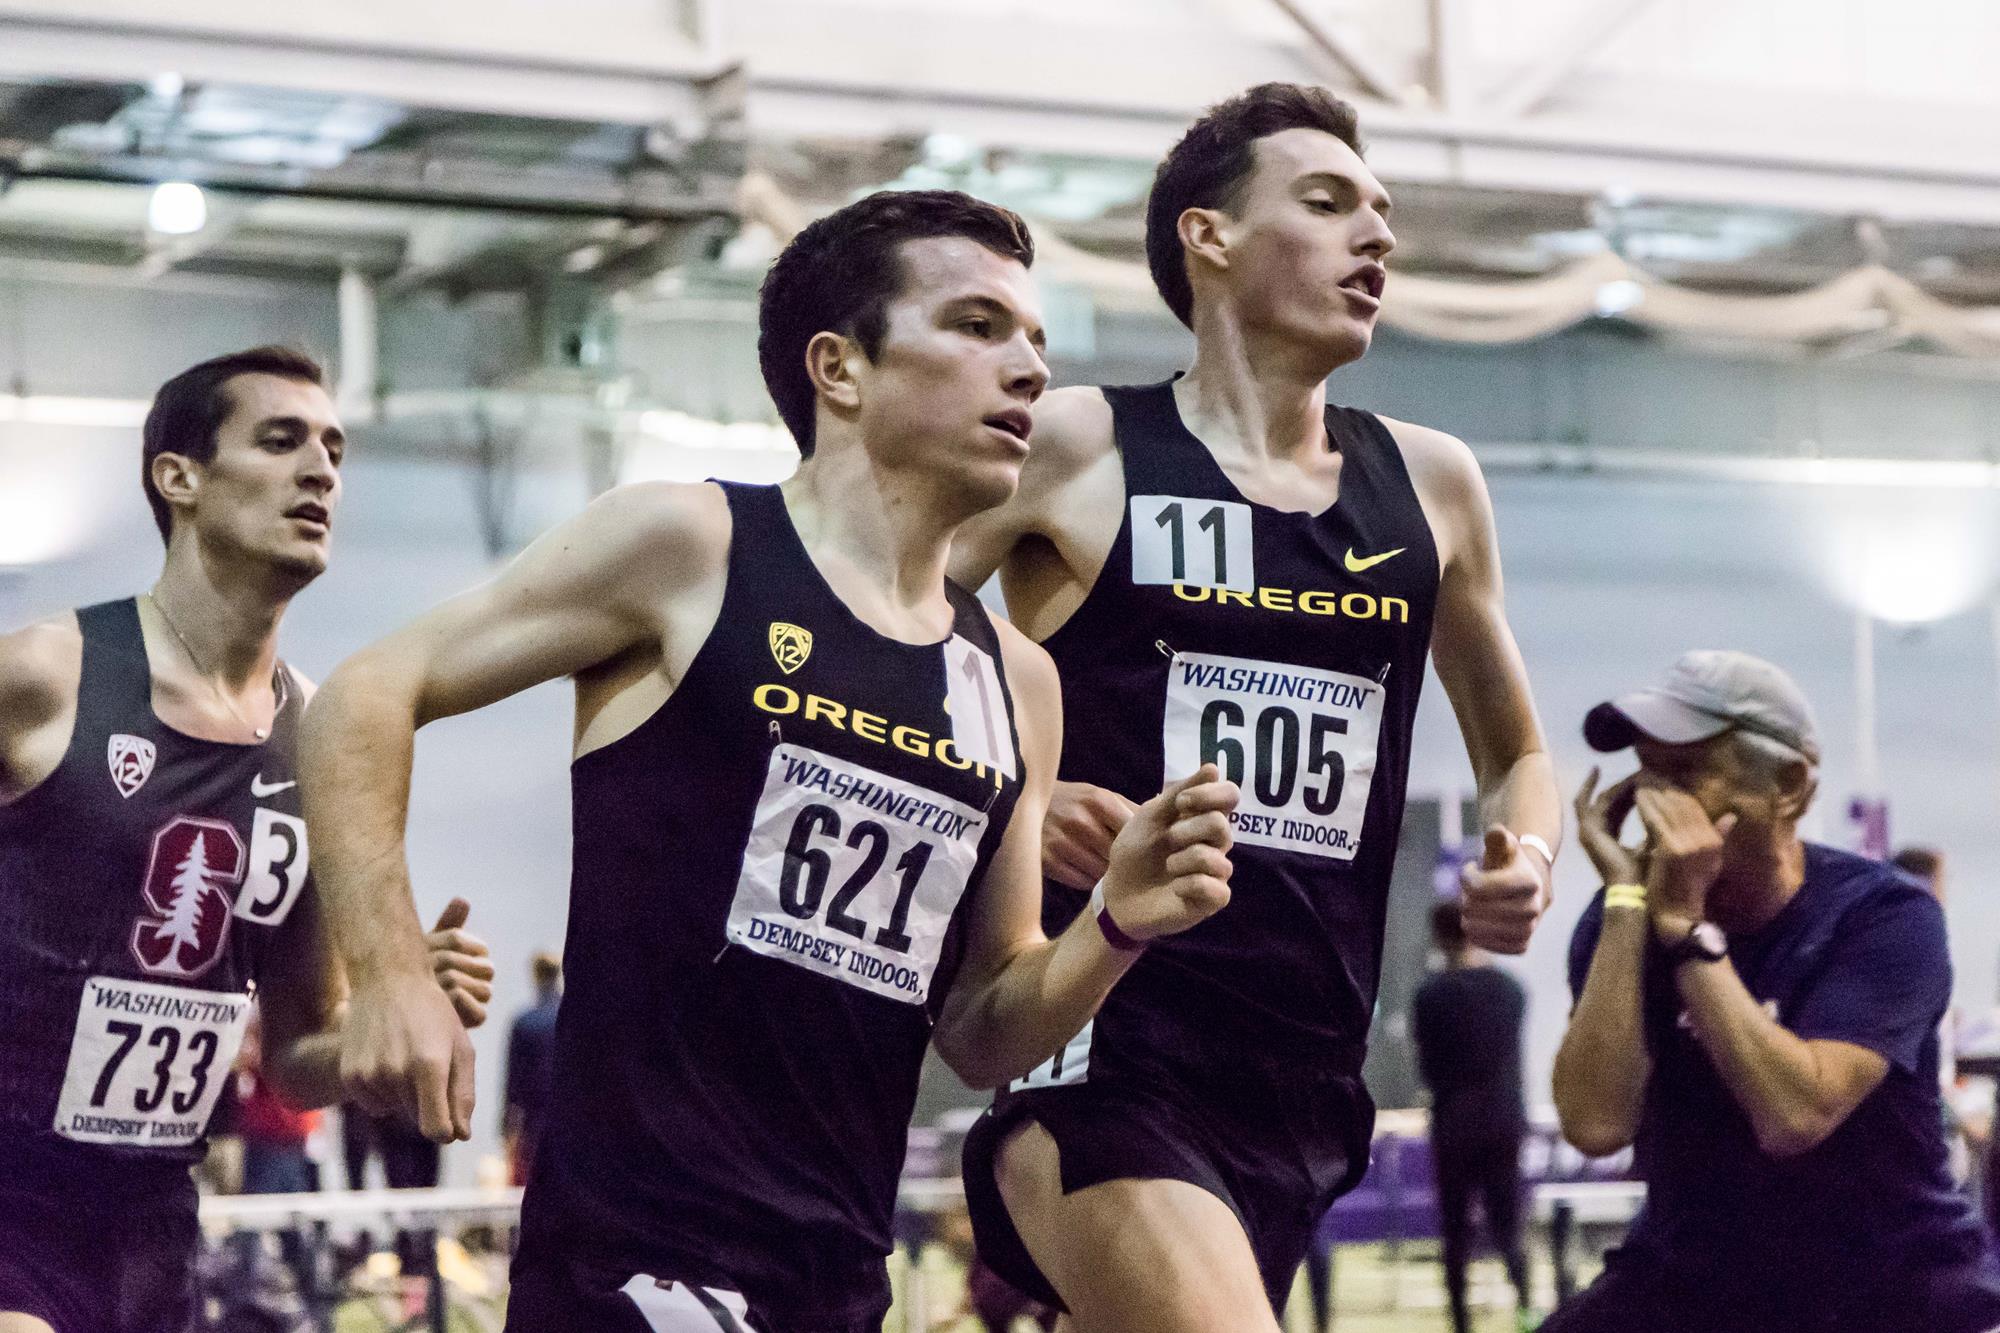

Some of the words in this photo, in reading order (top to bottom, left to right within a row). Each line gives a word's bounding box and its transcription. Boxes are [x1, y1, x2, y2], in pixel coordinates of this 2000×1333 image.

[1155, 502, 1227, 584] 11
[780, 645, 800, 664] 12
[1183, 662, 1376, 710] WASHINGTON
[962, 650, 1000, 764] 1
[117, 761, 140, 785] 12
[784, 756, 980, 841] WASHINGTON
[1200, 699, 1348, 816] 605
[1229, 811, 1277, 836] PSEY
[250, 822, 297, 918] 3
[778, 803, 934, 954] 621
[748, 917, 846, 967] DEMPSEY
[96, 987, 242, 1024] WASHINGTON
[90, 1019, 218, 1115] 733
